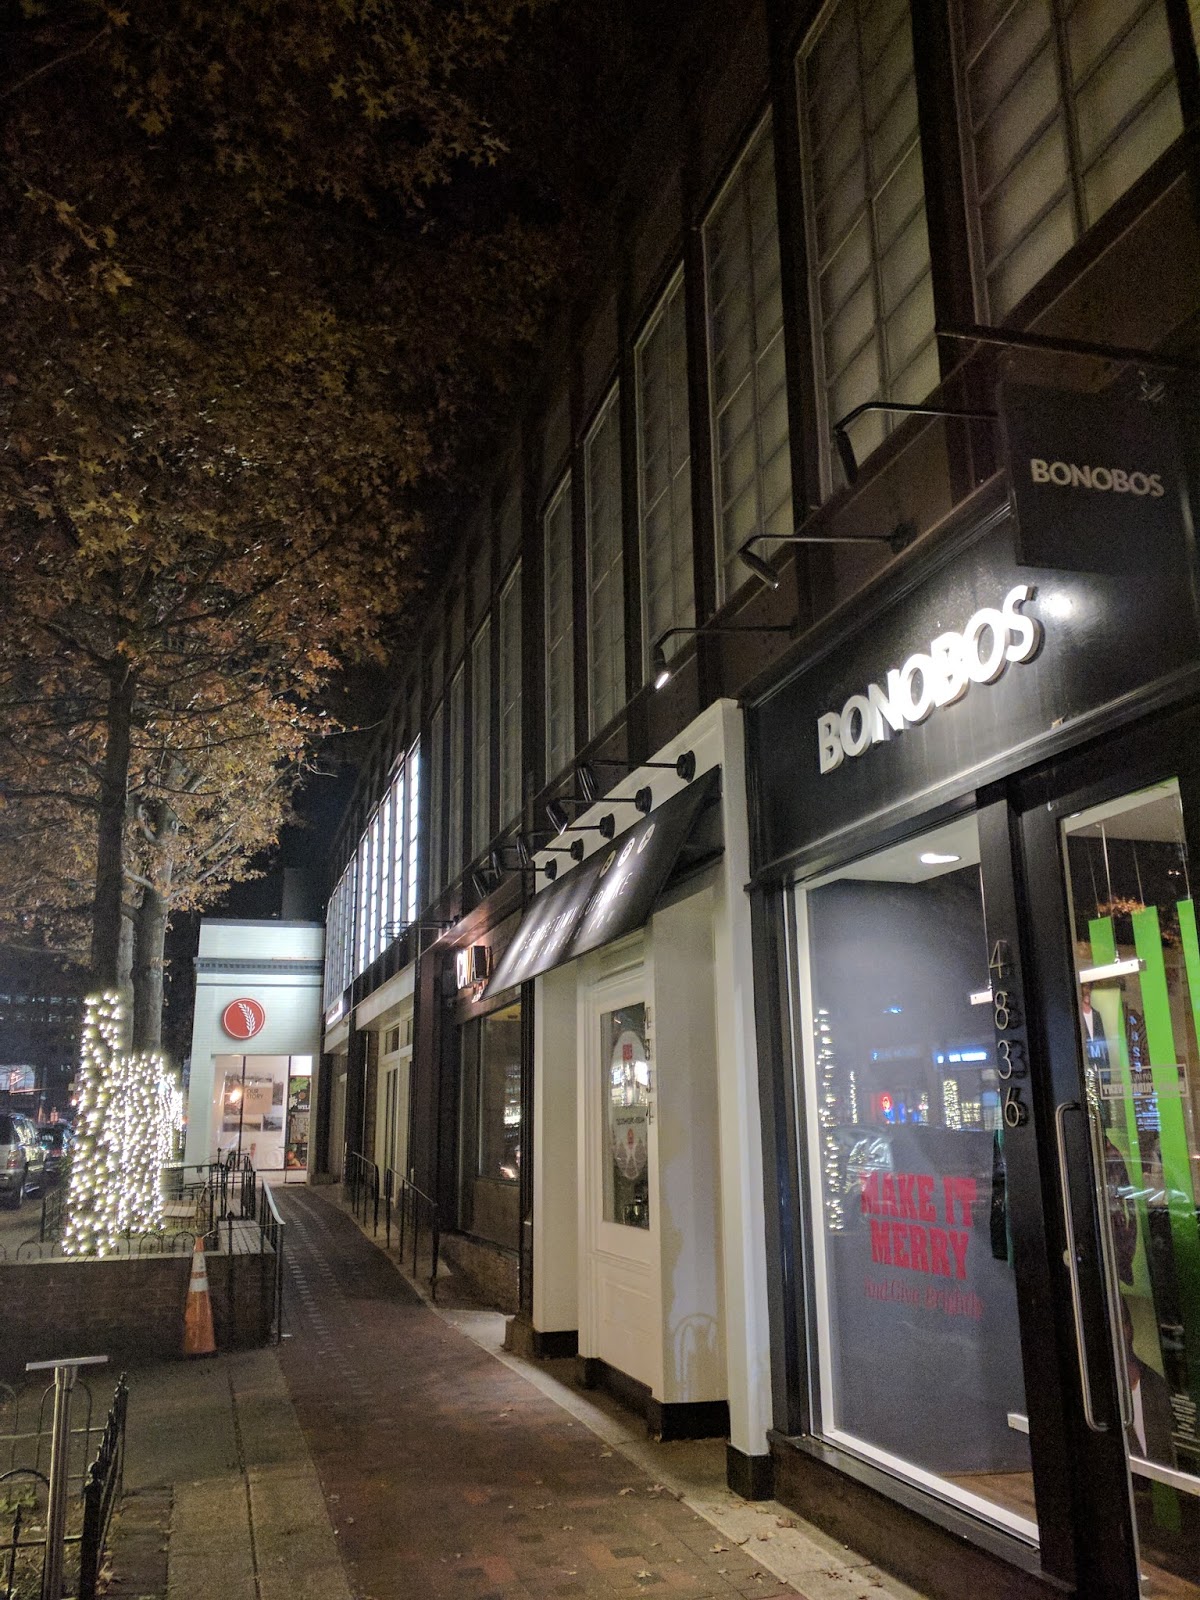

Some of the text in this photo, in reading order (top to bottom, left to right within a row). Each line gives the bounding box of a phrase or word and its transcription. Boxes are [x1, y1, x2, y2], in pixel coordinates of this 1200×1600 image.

[1030, 458, 1165, 497] BONOBOS
[817, 584, 1040, 775] BONOBOS
[989, 940, 1020, 1127] 4836
[859, 1171, 977, 1228] MAKE IT
[869, 1218, 969, 1281] MERRY
